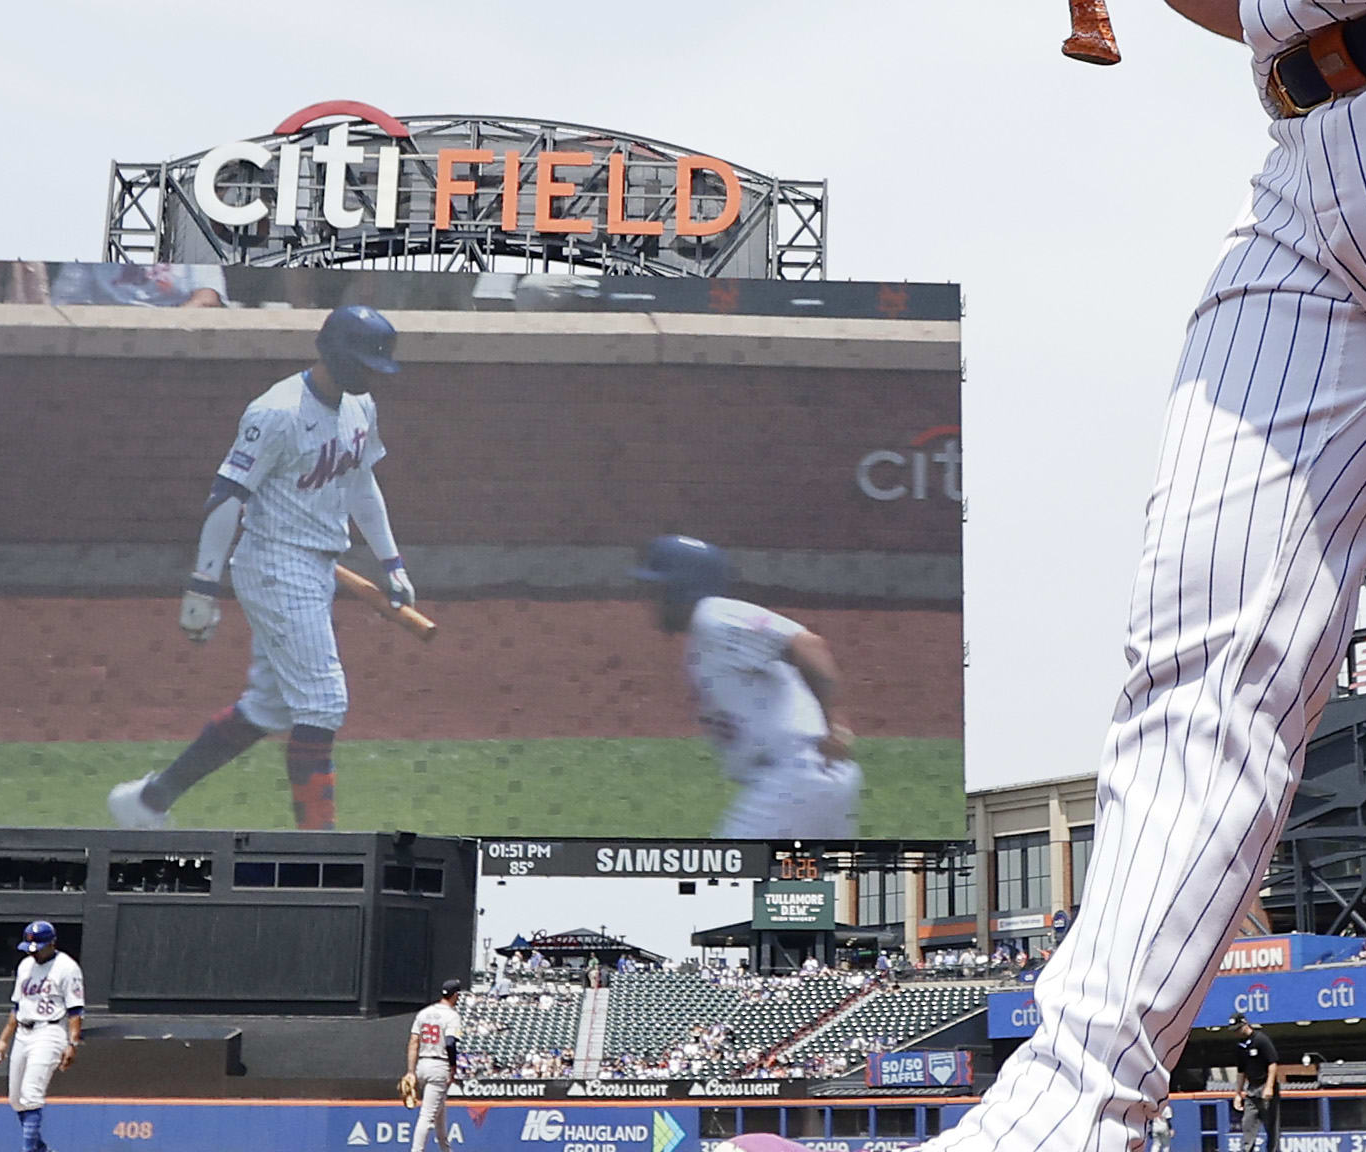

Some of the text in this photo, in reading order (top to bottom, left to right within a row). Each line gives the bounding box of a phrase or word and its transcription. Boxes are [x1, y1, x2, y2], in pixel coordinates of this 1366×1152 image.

[195, 122, 742, 237] citi FIELD
[857, 440, 961, 501] cit
[489, 845, 551, 858] 01:51 PM
[510, 861, 534, 875] 85°
[597, 848, 742, 873] SAMSUNG
[782, 858, 818, 879] 0:26
[764, 894, 824, 905] TULLAMORE
[1235, 986, 1270, 1013] citi
[1318, 980, 1355, 1008] citi
[37, 999, 54, 1015] 66
[882, 1058, 923, 1072] 50/50
[882, 1071, 925, 1085] RAFFLE
[463, 1079, 545, 1096] Coors LIGHT
[586, 1079, 668, 1096] Coors LIGHT
[704, 1078, 780, 1096] Coors LIGHT
[113, 1121, 153, 1139] 408
[376, 1123, 464, 1143] DEA
[564, 1126, 648, 1142] HAUGLAND
[1280, 1135, 1341, 1152] UNKIN'
